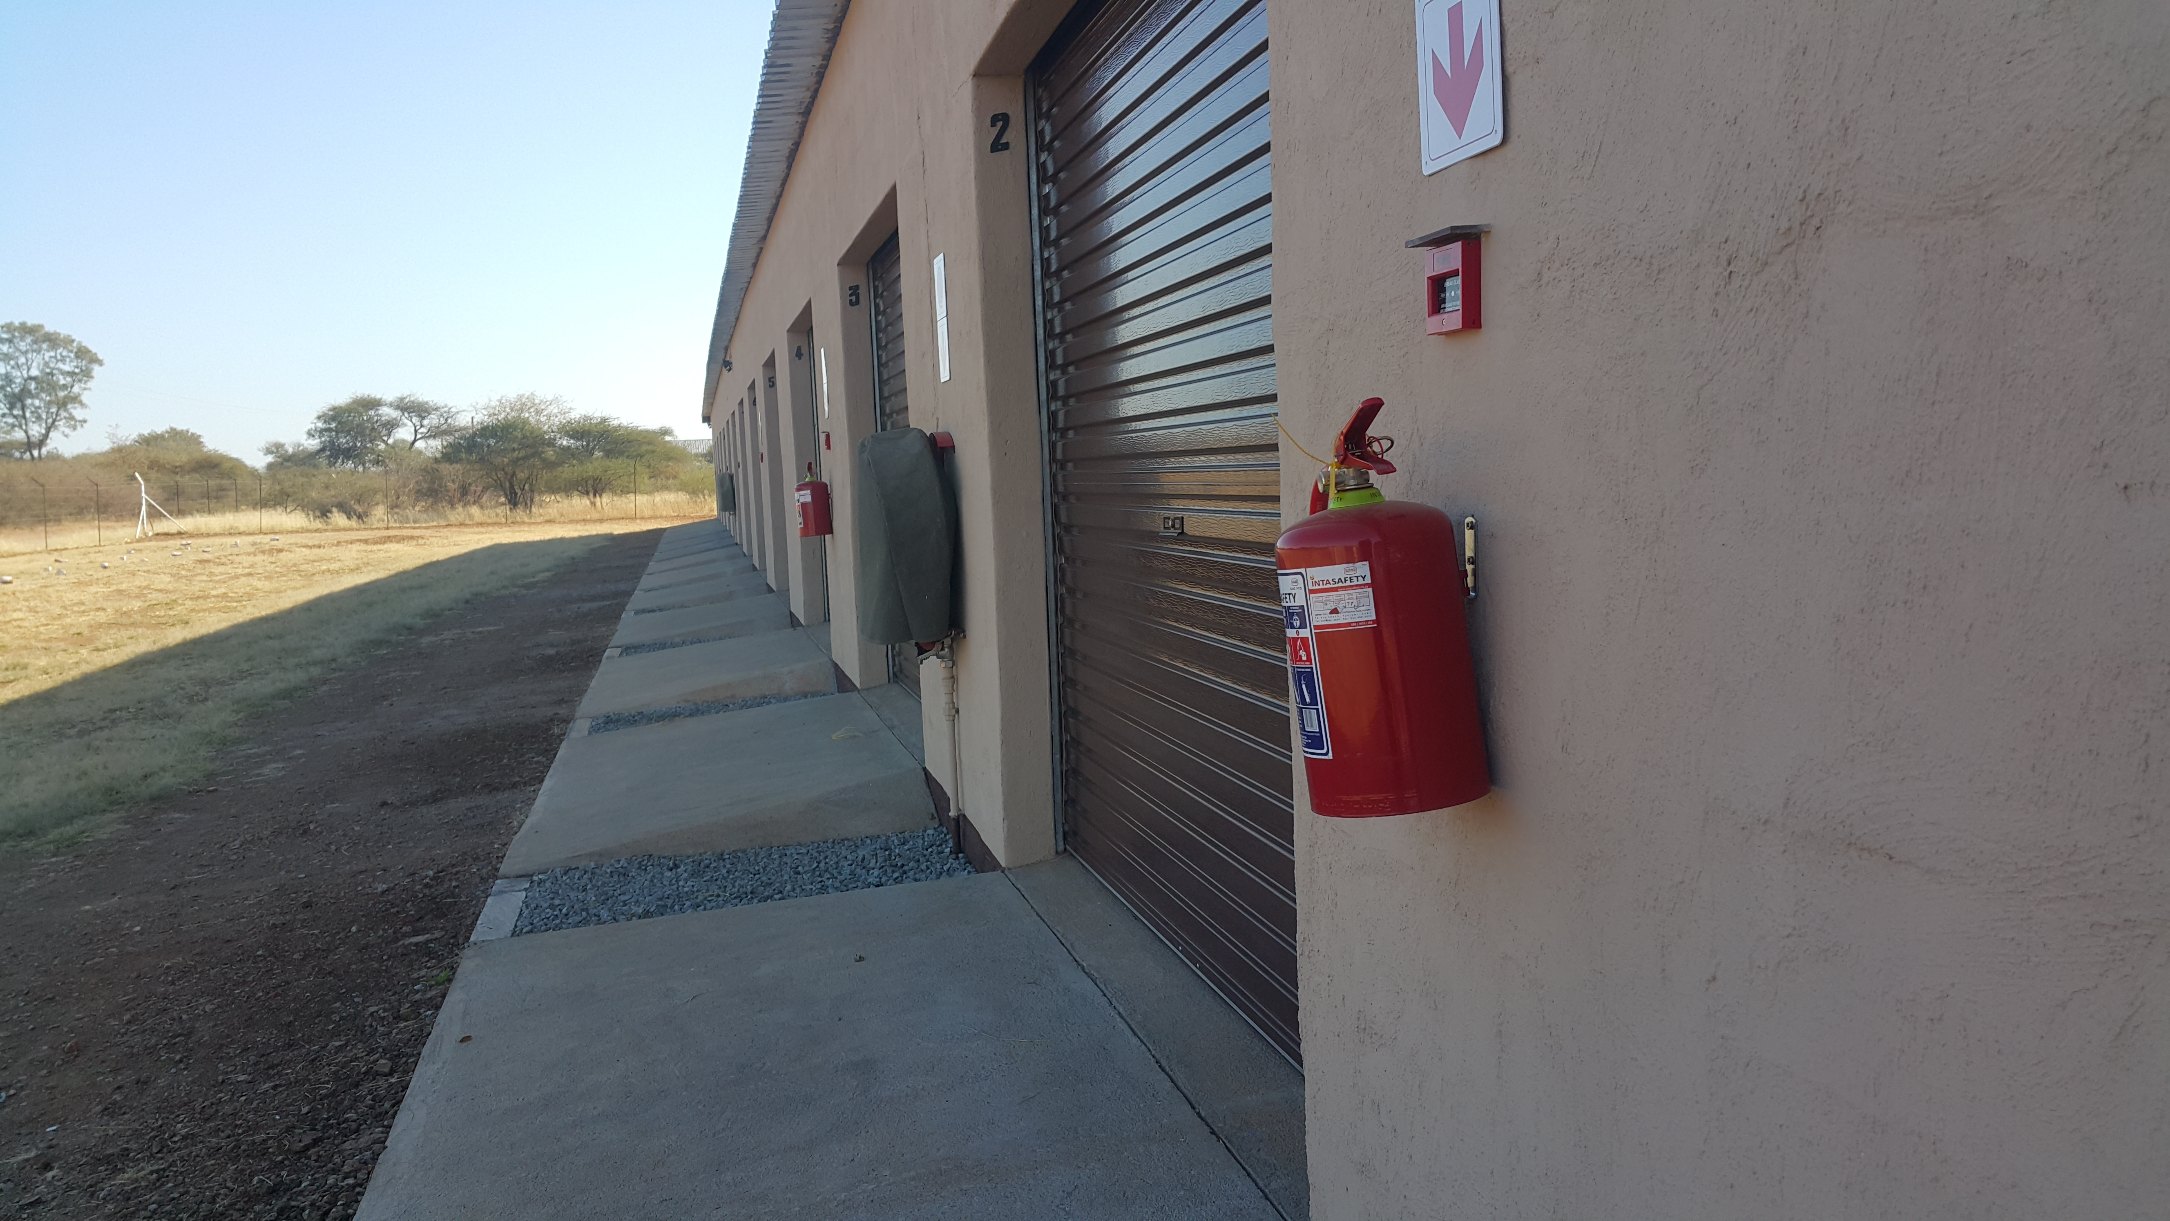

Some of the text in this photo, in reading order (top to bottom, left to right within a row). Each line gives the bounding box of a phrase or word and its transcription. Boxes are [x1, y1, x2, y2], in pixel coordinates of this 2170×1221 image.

[990, 112, 1010, 153] 2
[848, 284, 860, 307] 3
[795, 345, 803, 360] 4
[768, 377, 775, 388] 5
[1311, 574, 1367, 588] INTASAFETY
[1281, 592, 1297, 604] FETY
